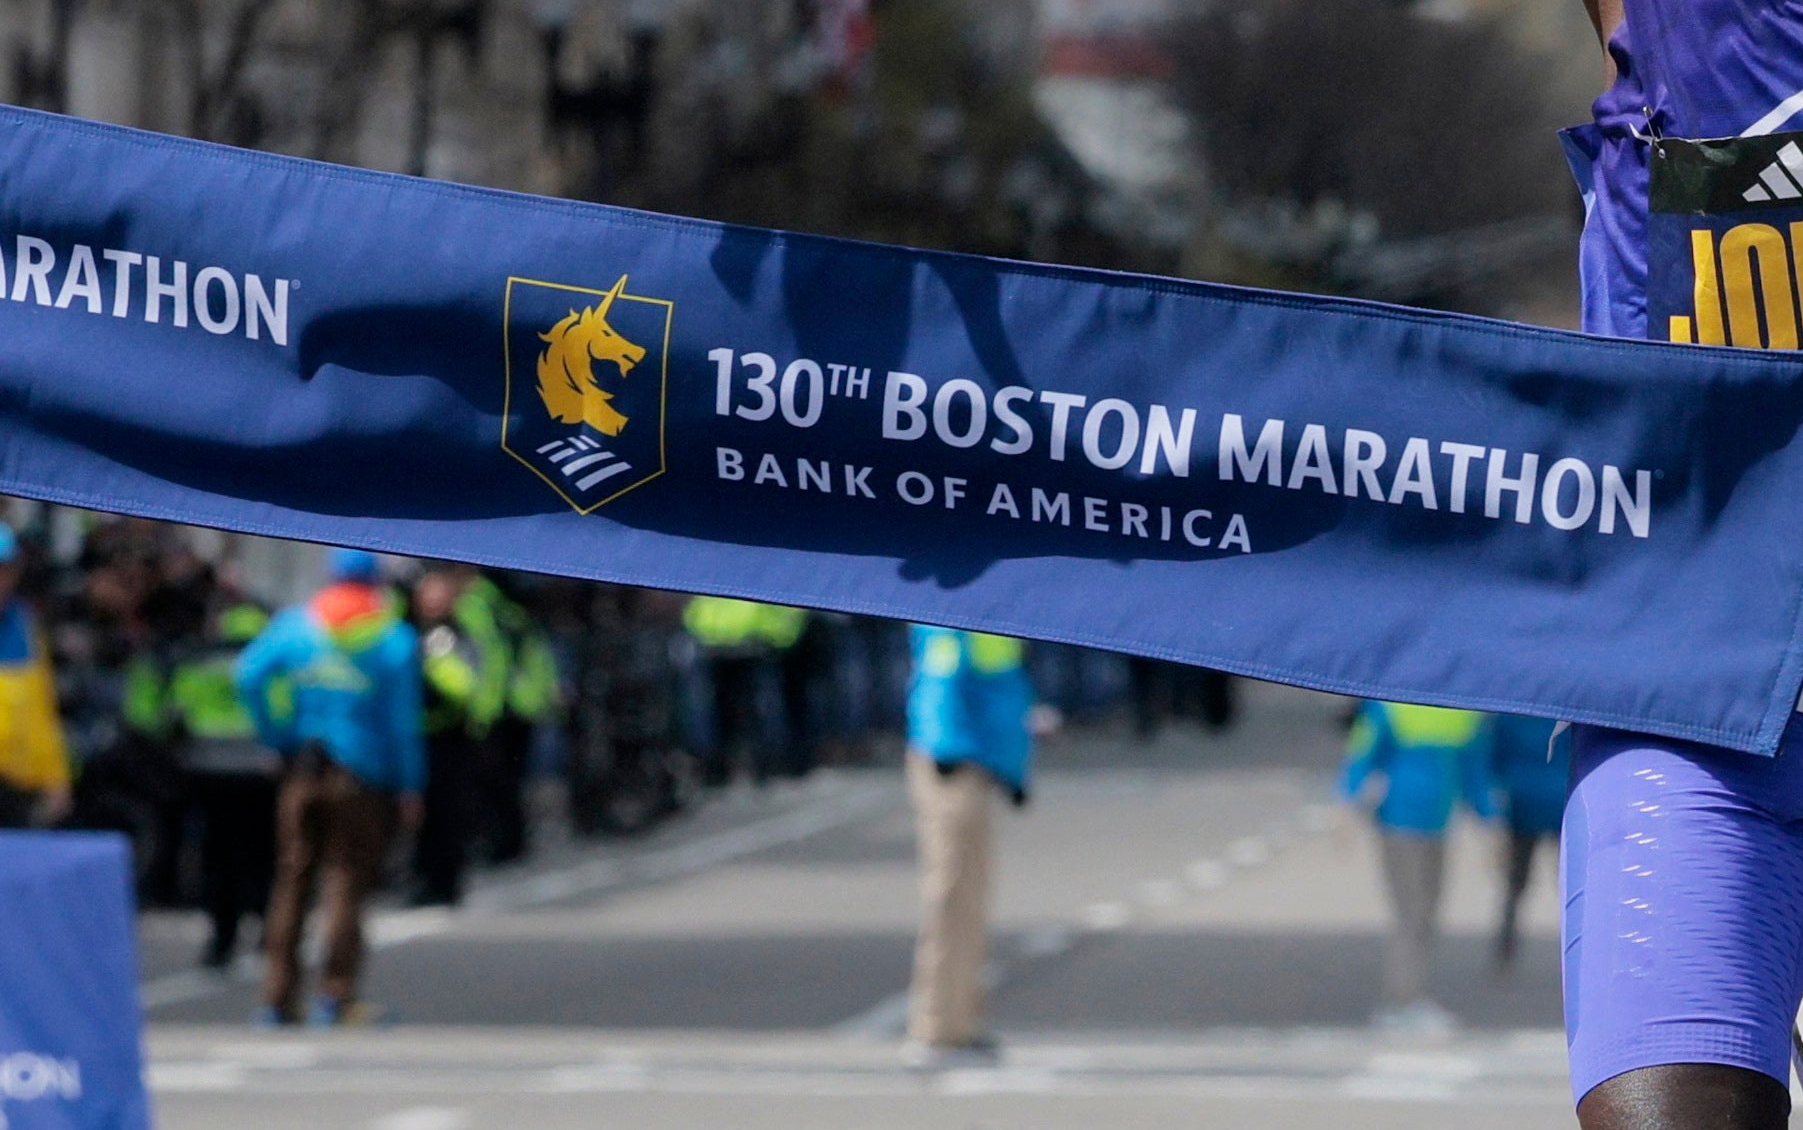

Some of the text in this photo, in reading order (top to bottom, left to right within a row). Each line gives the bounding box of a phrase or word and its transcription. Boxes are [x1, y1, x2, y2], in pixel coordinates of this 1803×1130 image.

[0, 234, 289, 347] RATHON
[707, 347, 1652, 539] 130TH BOSTON MARATHON
[716, 446, 1252, 554] BANK OF AMERICA
